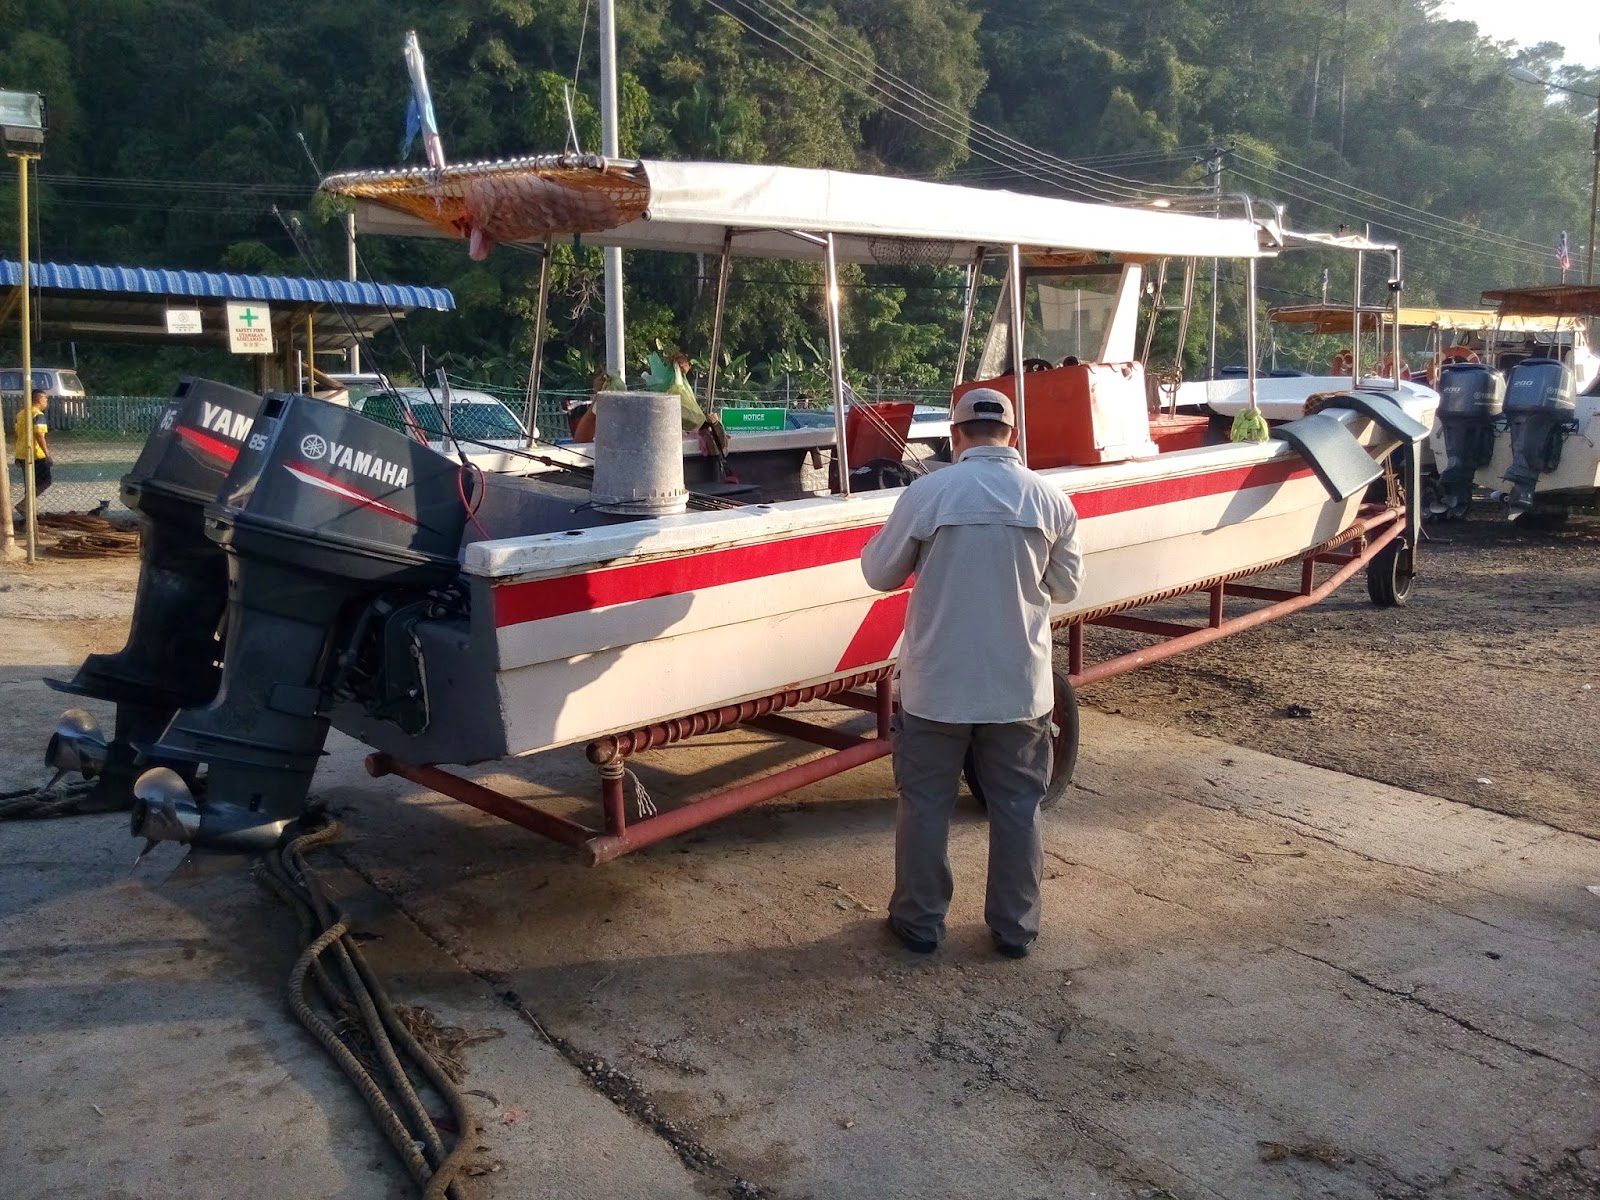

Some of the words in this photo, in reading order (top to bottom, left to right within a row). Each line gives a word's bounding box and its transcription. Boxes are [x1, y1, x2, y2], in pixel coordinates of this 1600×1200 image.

[202, 401, 254, 442] YAM
[743, 413, 765, 421] NOTICE
[248, 433, 269, 451] 85
[329, 441, 409, 489] YAMAHA
